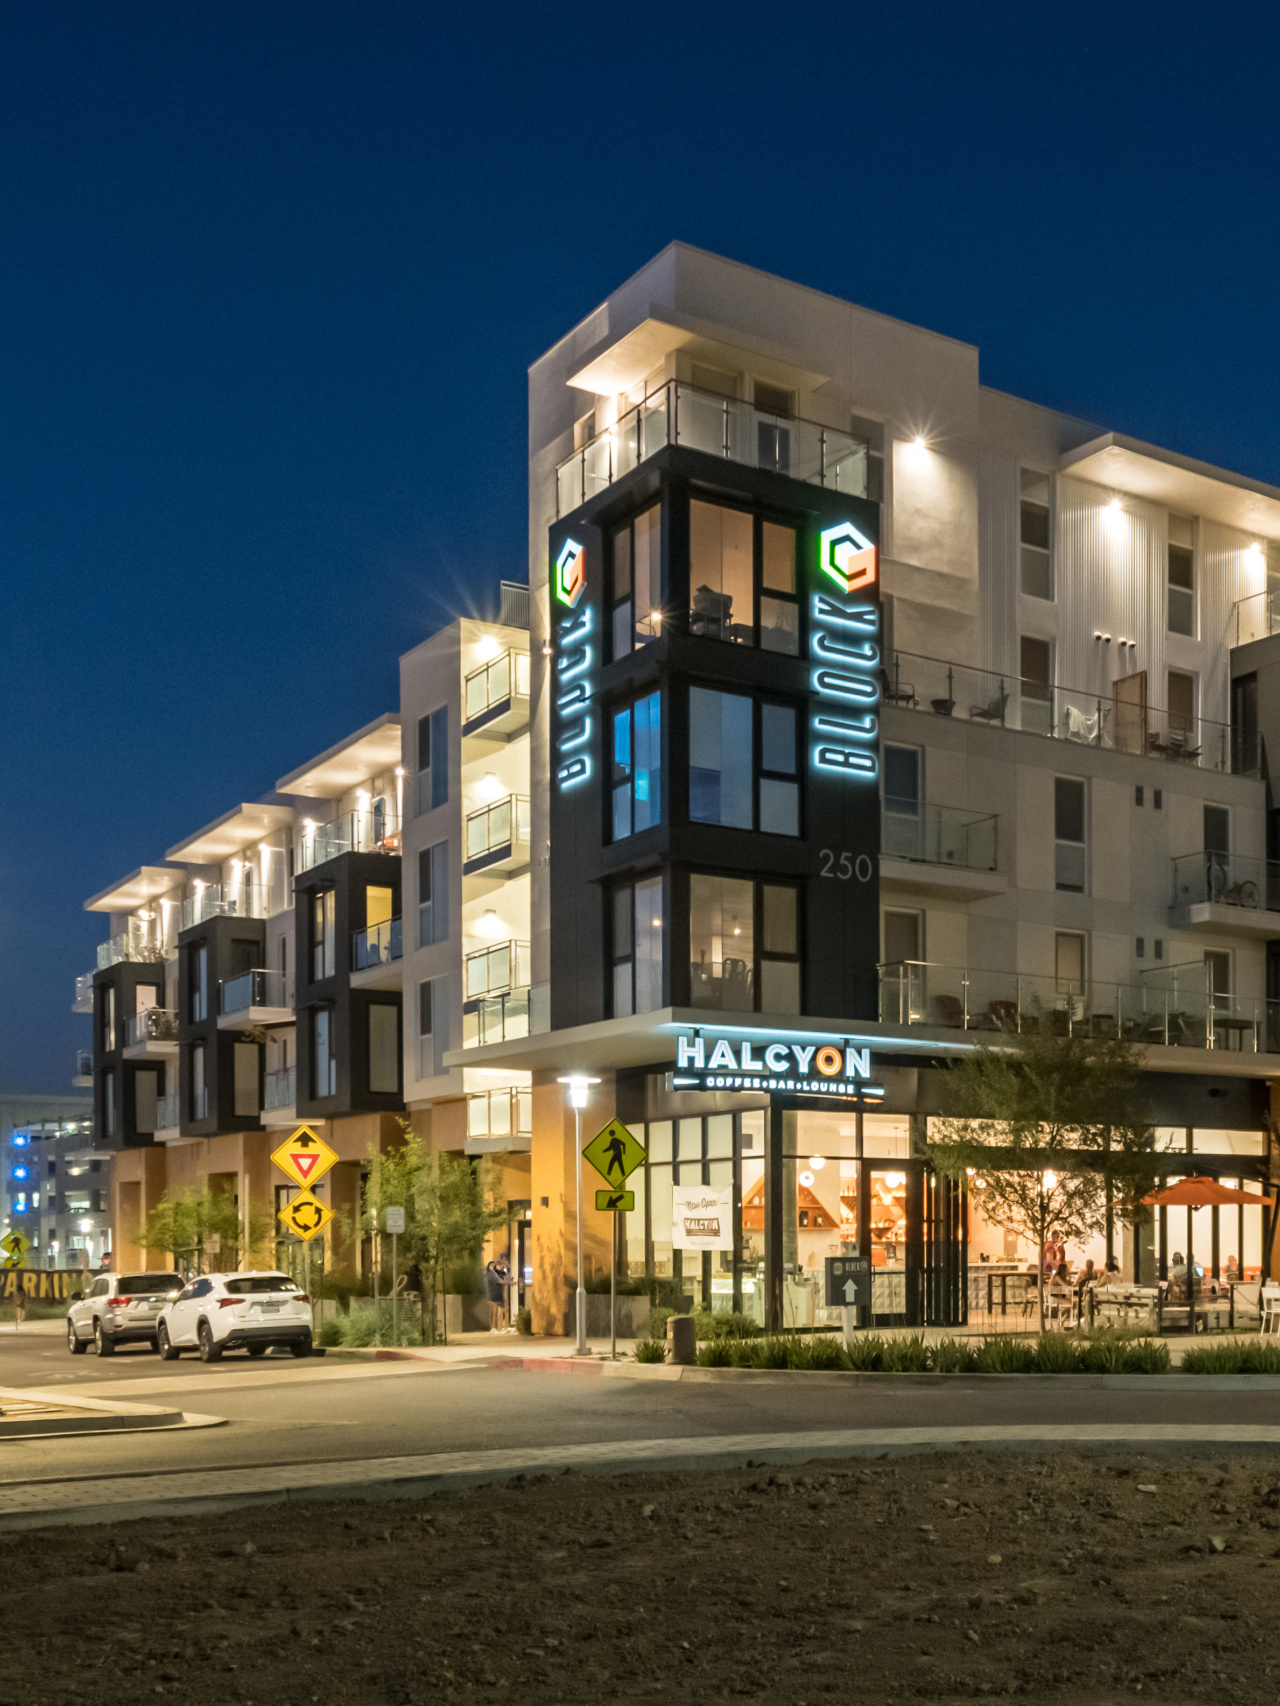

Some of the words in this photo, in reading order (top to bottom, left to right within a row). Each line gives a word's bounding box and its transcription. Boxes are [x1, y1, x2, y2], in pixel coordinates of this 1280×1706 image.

[556, 604, 592, 789] BLOCK
[817, 594, 879, 774] BLOCK
[819, 849, 872, 882] 250
[677, 1035, 871, 1079] HALCYON
[685, 1219, 719, 1230] HALCYON
